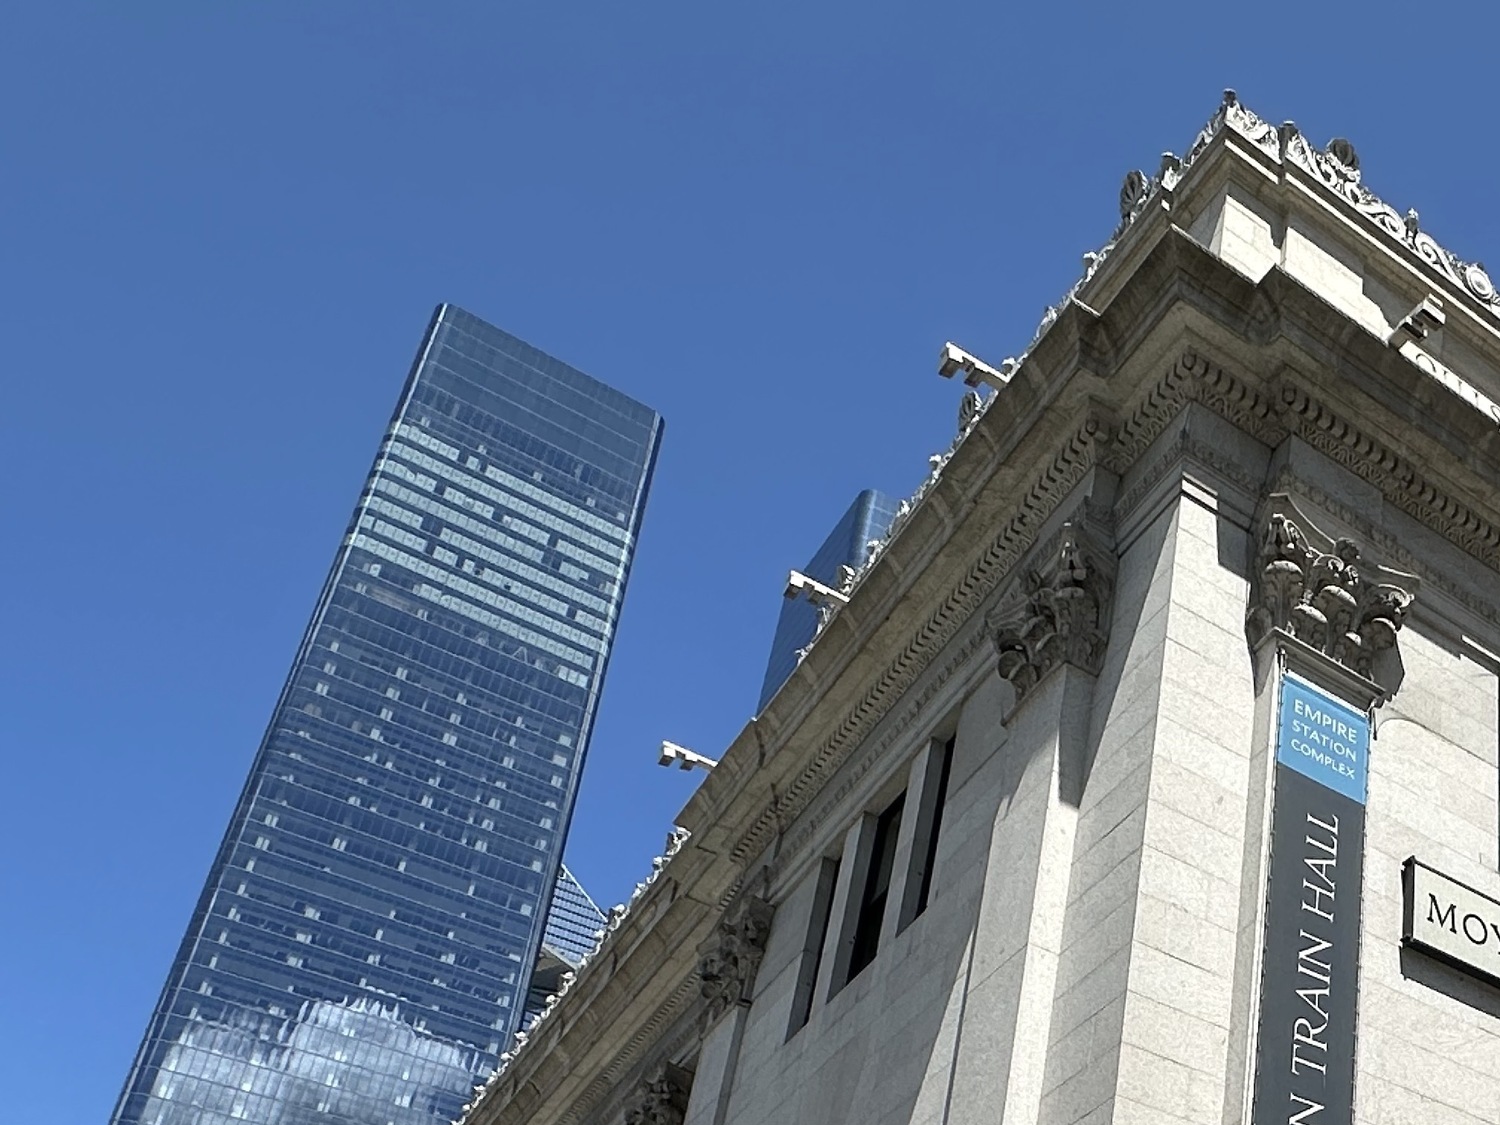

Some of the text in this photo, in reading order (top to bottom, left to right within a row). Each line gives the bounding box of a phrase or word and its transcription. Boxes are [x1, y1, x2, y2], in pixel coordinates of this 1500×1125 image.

[1291, 719, 1357, 762] STATION
[1294, 698, 1357, 745] EMPIRE
[1290, 738, 1355, 780] COMPLEX
[1300, 812, 1340, 924] HALL
[1290, 929, 1334, 1076] TRAIN
